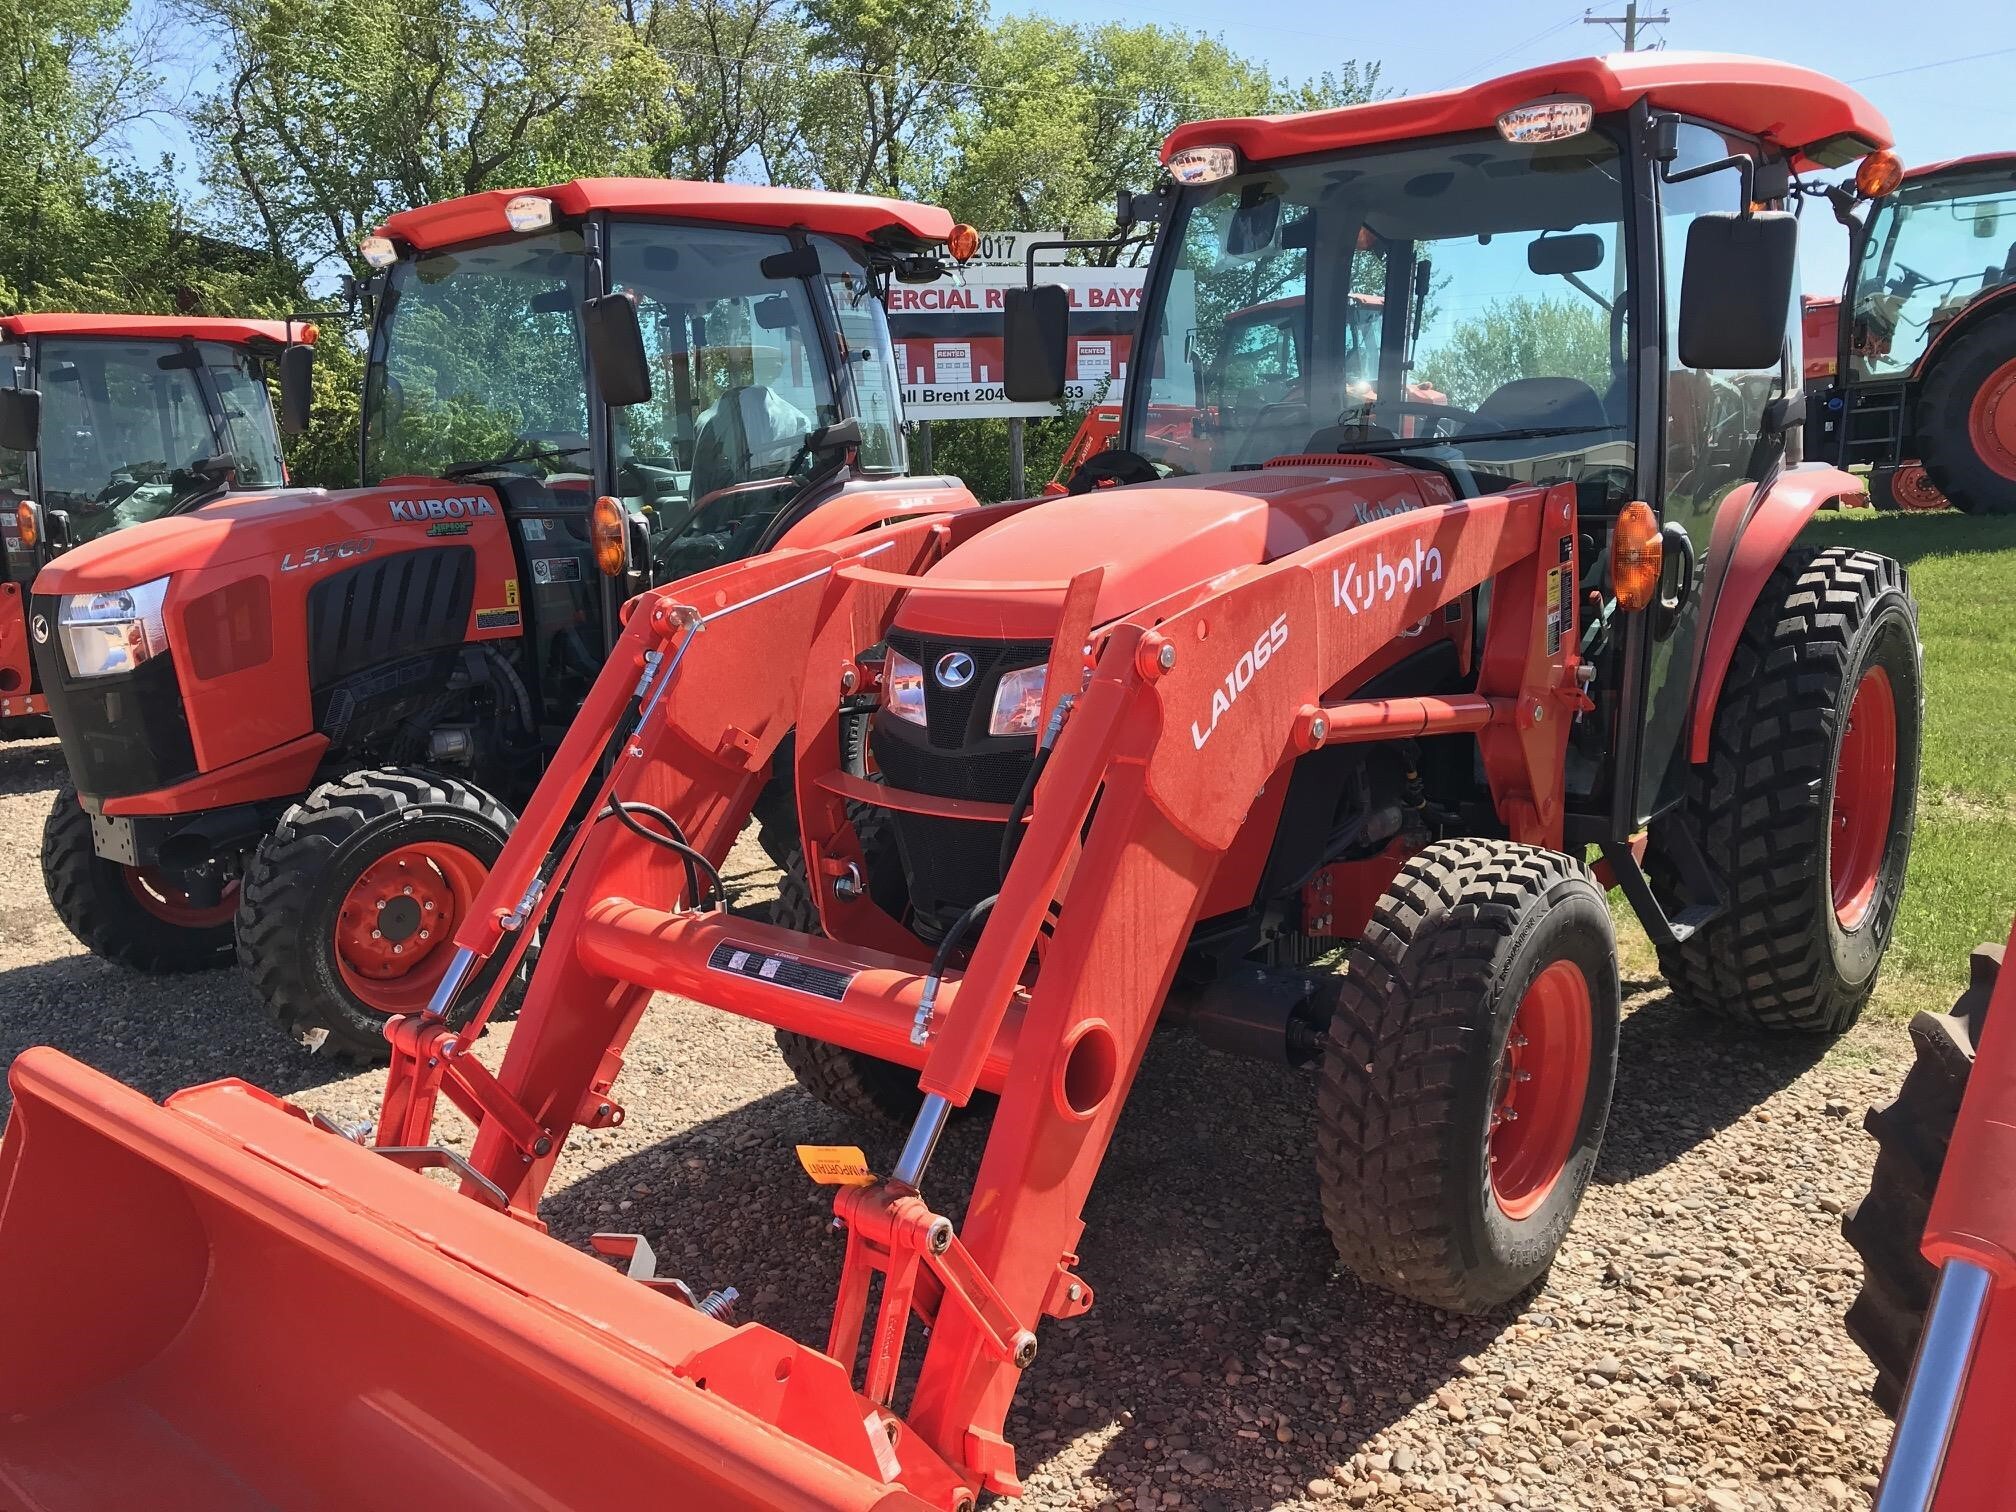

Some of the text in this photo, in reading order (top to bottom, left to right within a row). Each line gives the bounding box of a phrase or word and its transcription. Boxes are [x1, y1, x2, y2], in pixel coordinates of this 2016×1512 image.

[888, 288, 979, 309] ERCIAL
[937, 350, 965, 358] RENTED
[1079, 347, 1105, 355] RENTED
[922, 389, 969, 403] Brent
[389, 496, 496, 522] KUBOTA
[280, 536, 376, 572] L3560
[1333, 540, 1442, 615] Kubota
[1191, 613, 1289, 750] LA1065
[807, 1163, 861, 1177] IMPORTANT
